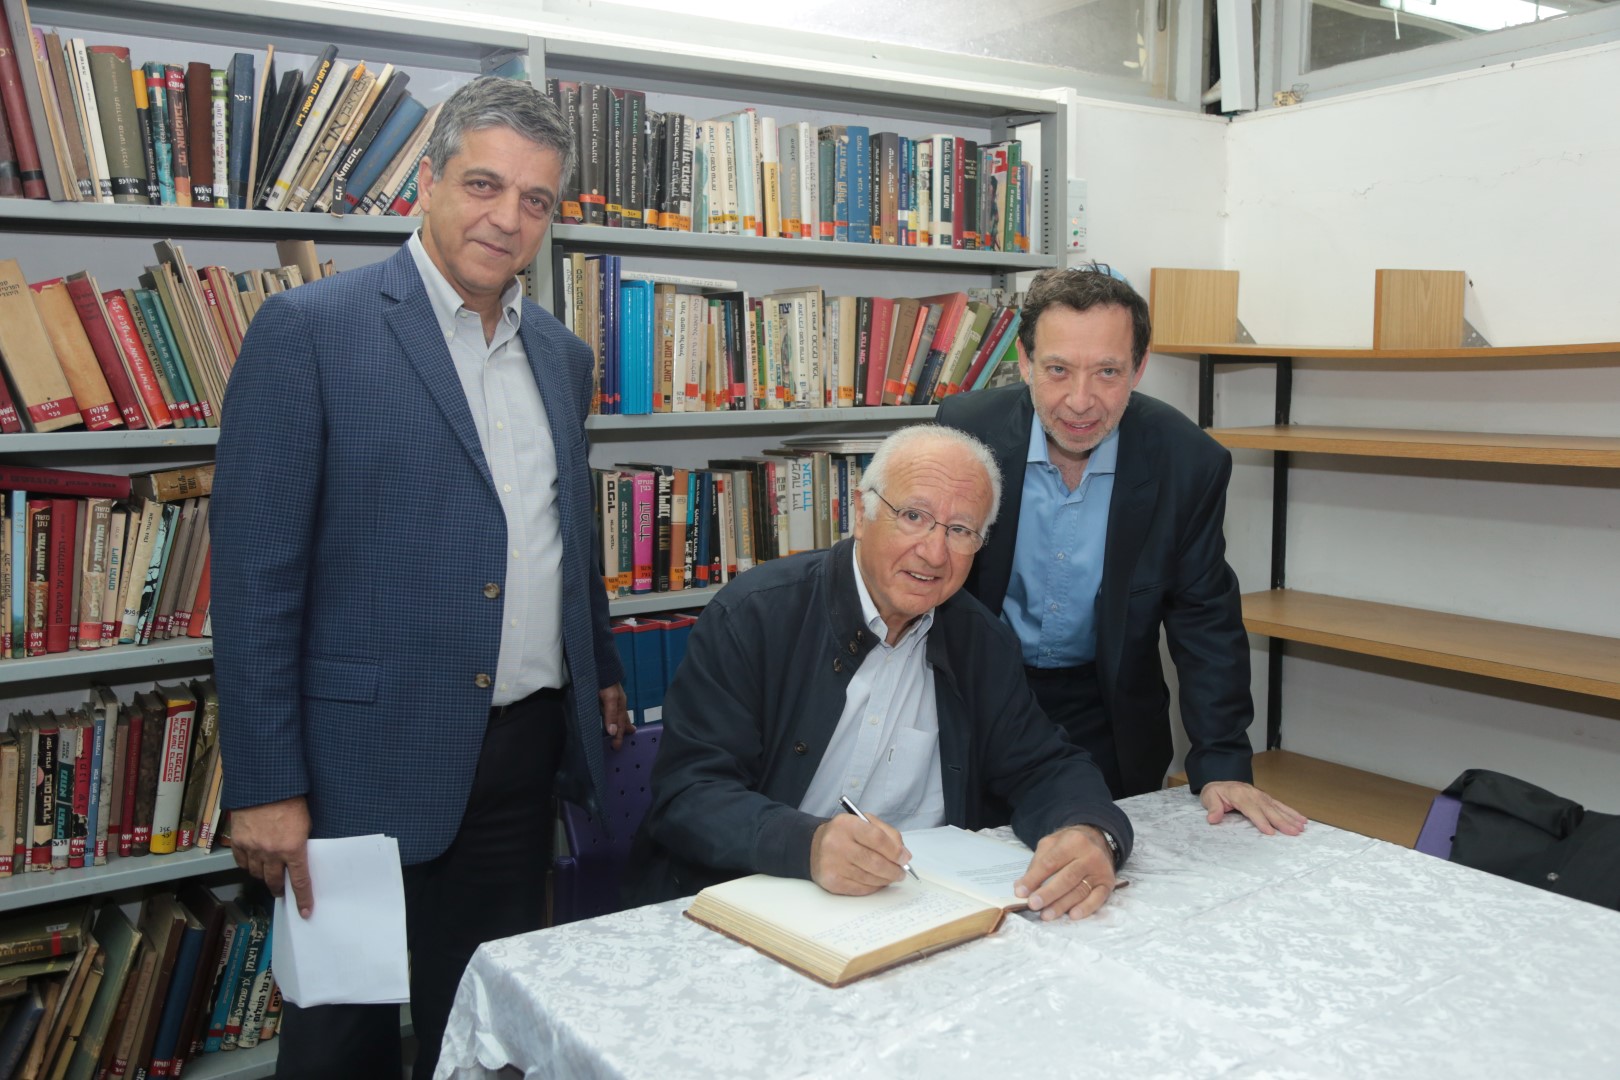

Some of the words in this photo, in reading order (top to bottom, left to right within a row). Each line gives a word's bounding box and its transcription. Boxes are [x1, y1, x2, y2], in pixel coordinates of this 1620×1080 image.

[314, 59, 331, 83] שיחות
[309, 81, 321, 95] עם
[350, 72, 370, 97] אבא
[300, 94, 315, 113] משה
[339, 95, 358, 118] אבן
[294, 112, 307, 127] דיין
[591, 102, 599, 132] בן-גוריון
[113, 95, 122, 122] תעודות
[119, 145, 130, 169] לובלין
[334, 145, 363, 182] אשכול
[838, 157, 847, 178] מאיר
[334, 185, 343, 201] לוי
[406, 180, 418, 192] לך
[691, 313, 699, 335] שאגאל
[130, 302, 144, 326] ישראל
[140, 326, 149, 338] לוי
[146, 342, 156, 356] איש
[152, 356, 164, 378] גינוסר
[663, 339, 672, 358] ראש
[678, 334, 684, 343] של
[751, 346, 756, 354] עם
[139, 371, 153, 392] ומים
[663, 359, 672, 382] בראש
[789, 463, 802, 489] משה
[801, 462, 812, 487] אבני
[606, 480, 615, 513] ספיר
[640, 484, 652, 493] בגין
[790, 492, 807, 511] דיין
[801, 490, 813, 511] דרך
[638, 500, 651, 542] המרד
[740, 507, 748, 531] משה
[93, 523, 105, 561] המלחמה
[693, 526, 698, 536] את
[35, 532, 47, 571] המלחמה
[742, 534, 750, 554] קצב
[56, 540, 66, 576] המלחמה
[34, 572, 45, 586] על
[55, 578, 63, 589] על
[107, 566, 117, 590] הלוחם
[33, 588, 44, 627] ירושלים
[55, 591, 64, 624] ירושלים
[175, 717, 187, 749] מרכבות
[171, 751, 183, 782] הפלדה
[43, 773, 53, 793] ביום
[57, 769, 69, 797] מתא
[243, 945, 262, 974] ויצמן
[241, 977, 251, 987] לך
[258, 980, 269, 994] על
[235, 987, 248, 1008] שמים
[251, 994, 266, 1023] השלום
